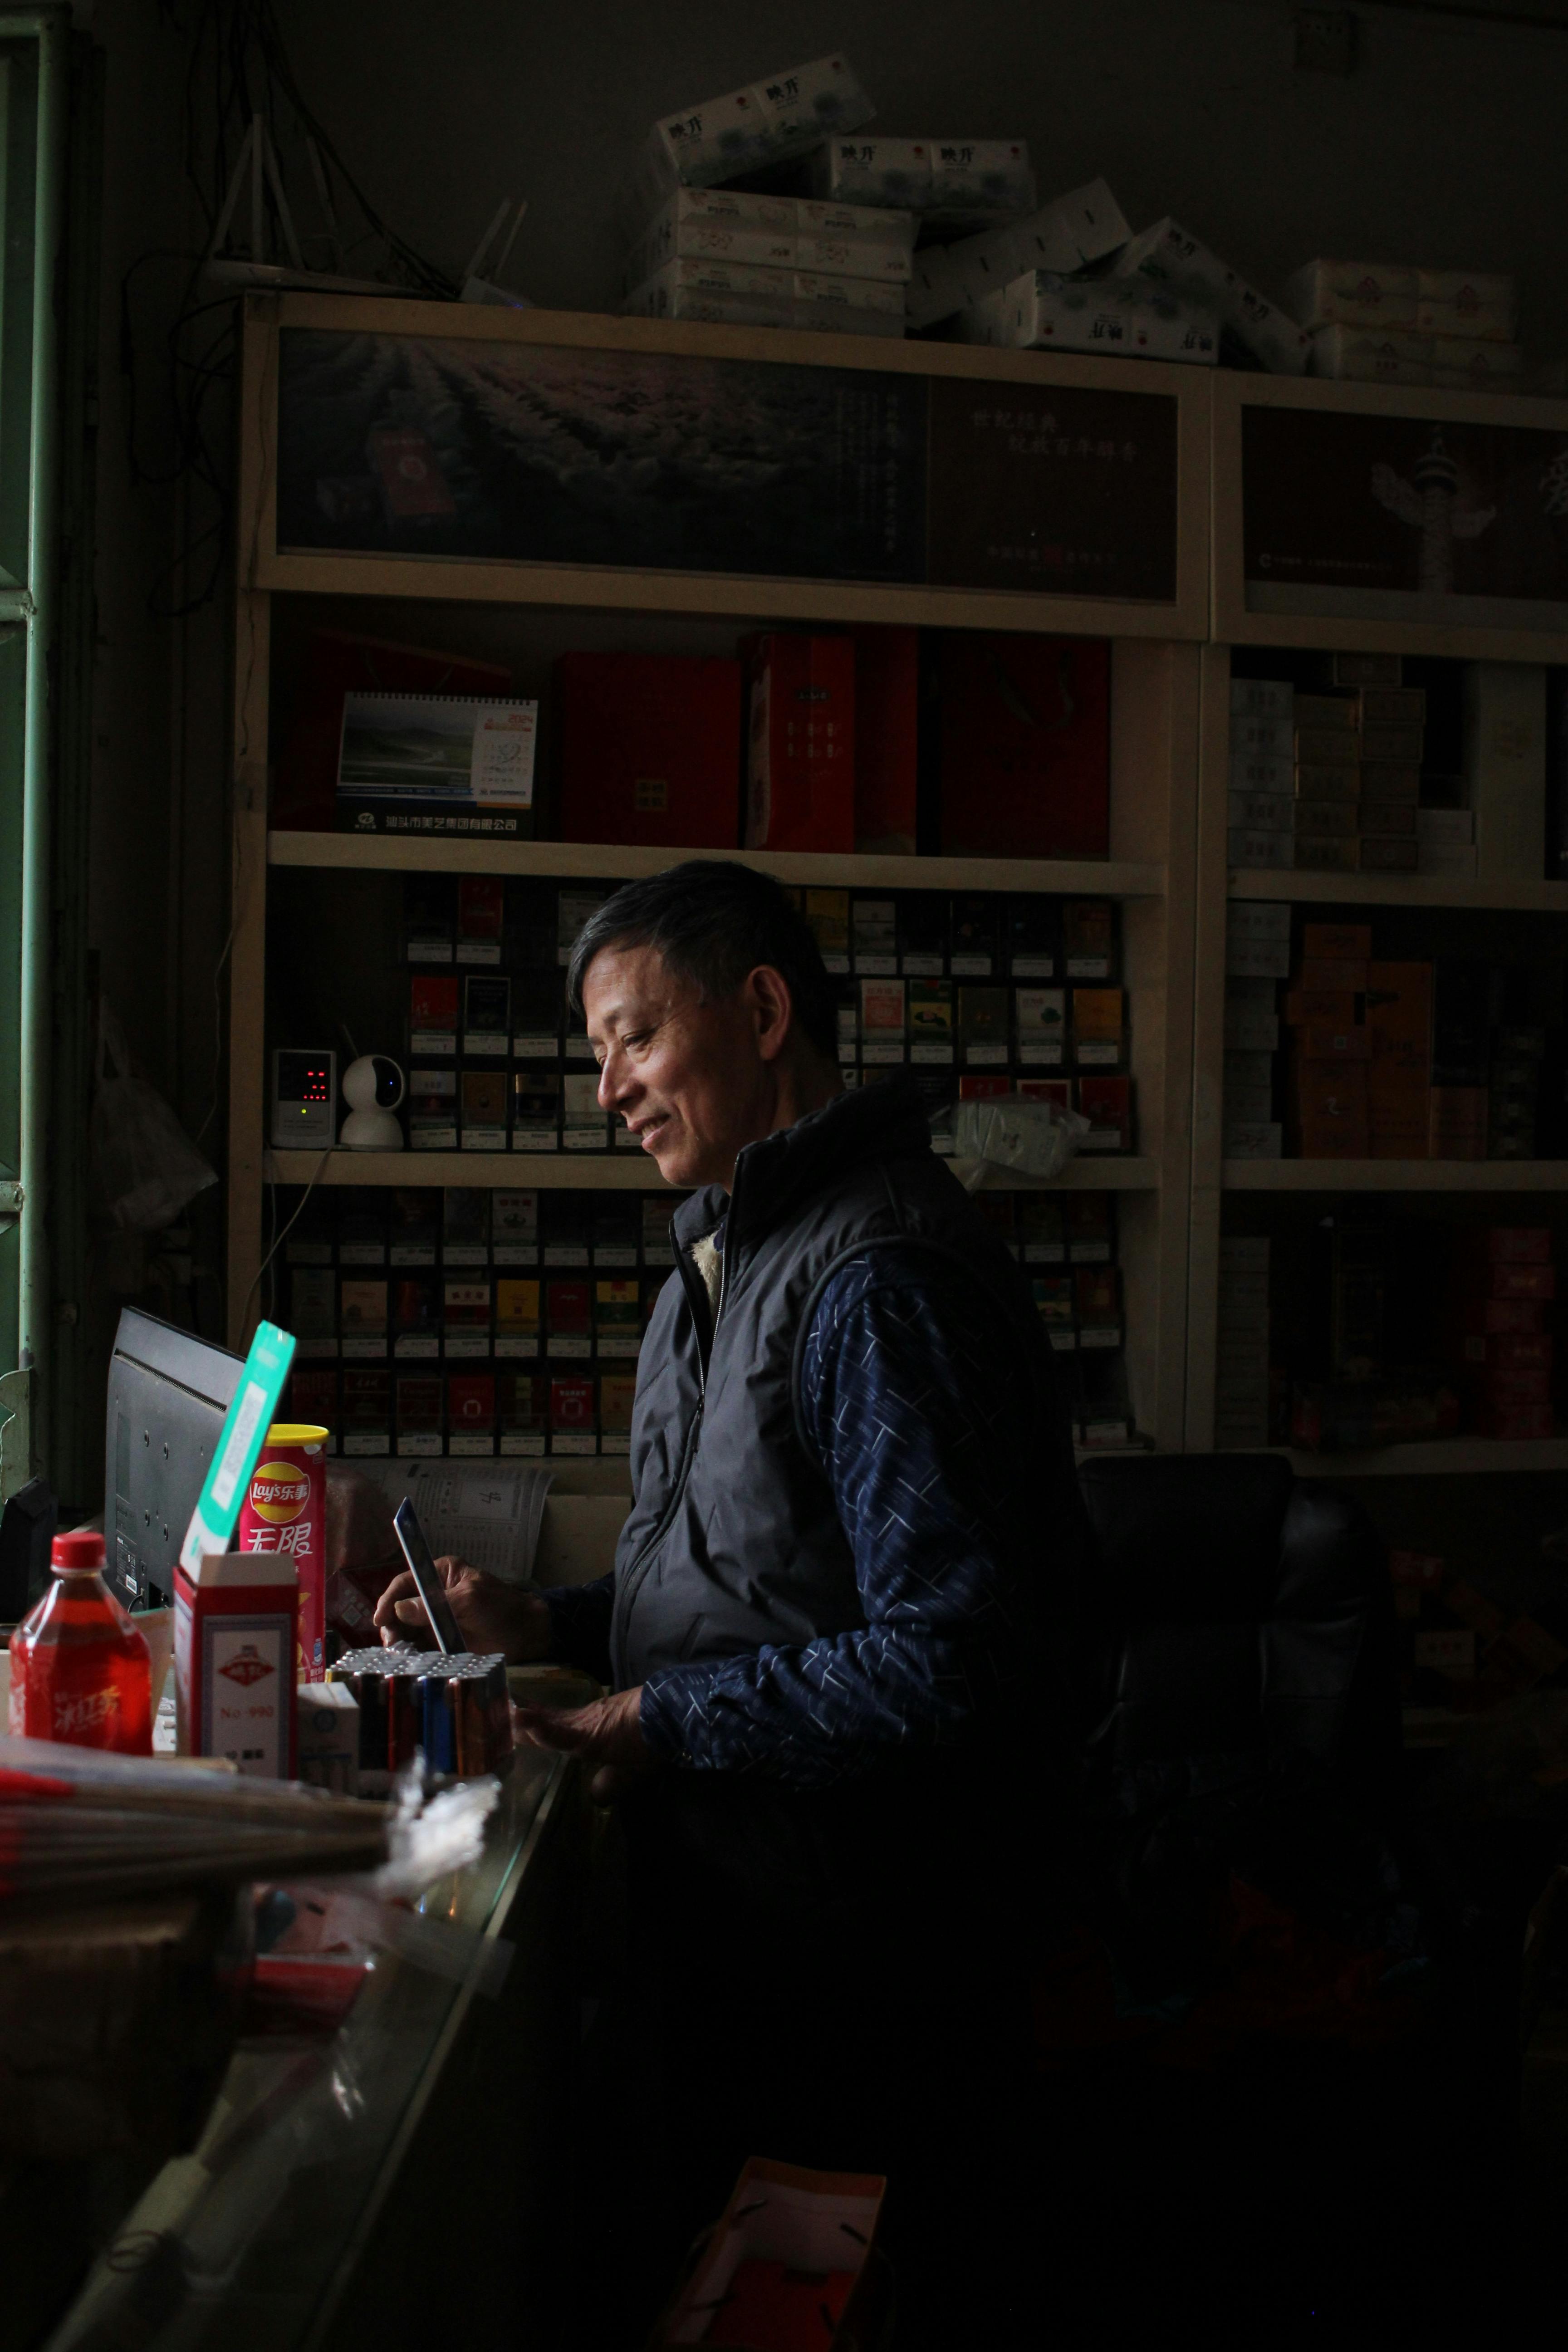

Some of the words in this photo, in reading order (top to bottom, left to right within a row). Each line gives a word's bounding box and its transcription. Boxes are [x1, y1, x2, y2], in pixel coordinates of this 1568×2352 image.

[509, 714, 533, 724] 2024
[386, 815, 517, 831] 汕头市美艺集团有限公司
[252, 1482, 282, 1503] Lay's
[279, 1484, 309, 1500] 乐事
[247, 1522, 313, 1558] 无限
